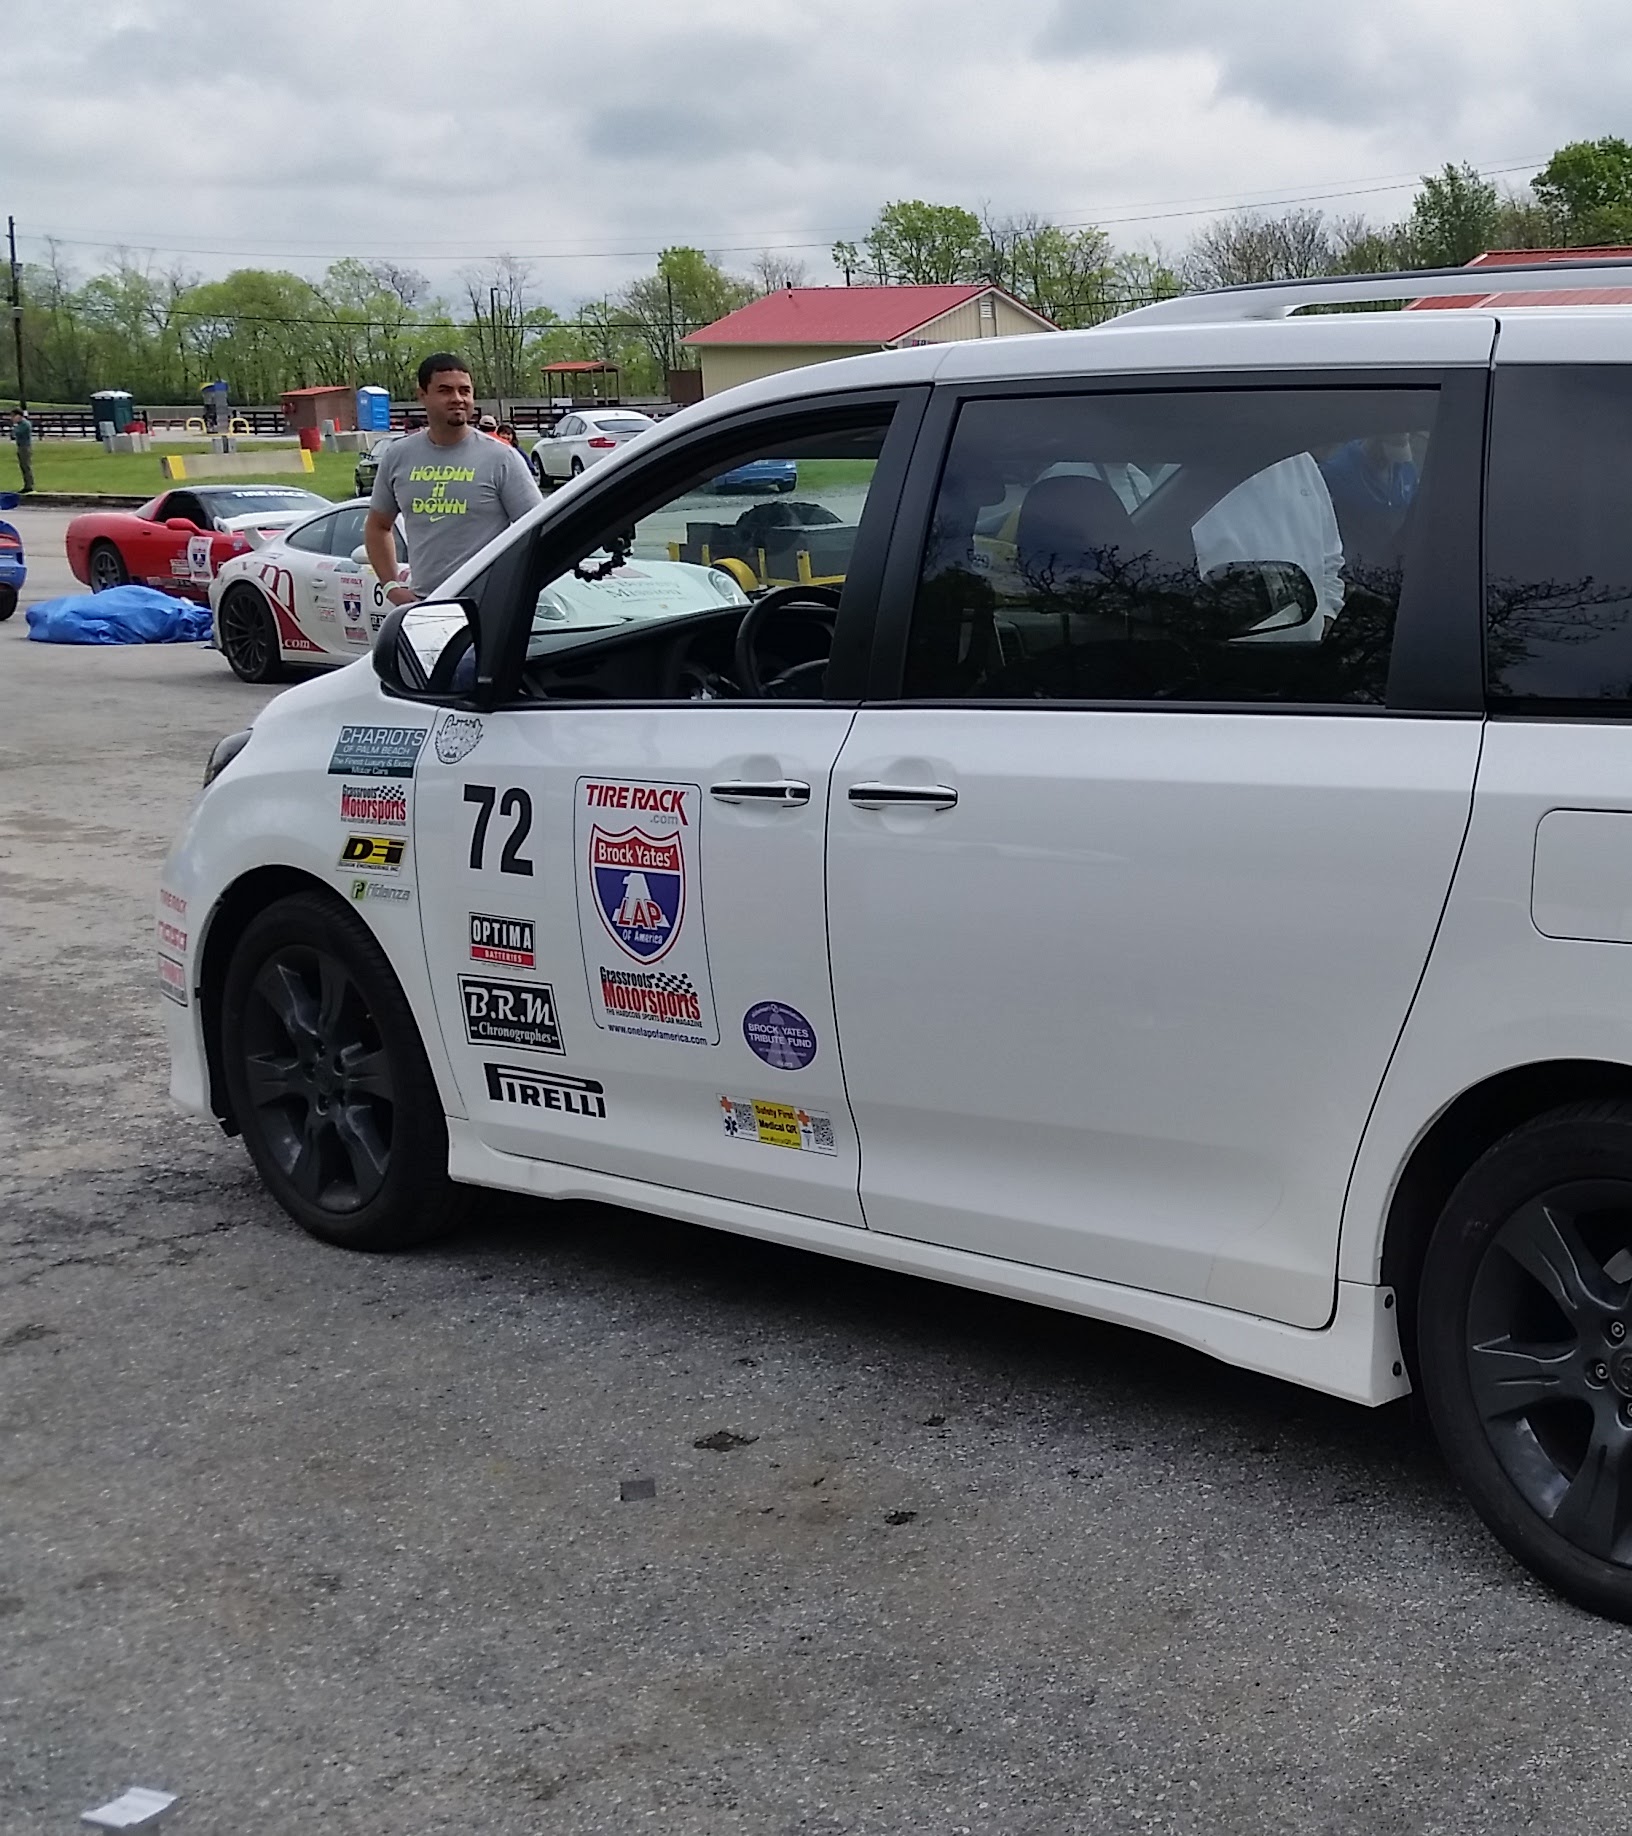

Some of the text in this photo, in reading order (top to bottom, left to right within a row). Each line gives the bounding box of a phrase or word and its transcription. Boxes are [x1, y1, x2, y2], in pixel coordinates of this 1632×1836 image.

[409, 465, 475, 482] HOLDIN
[432, 481, 449, 497] IT
[412, 497, 467, 514] DOWN
[283, 639, 310, 649] .com
[340, 727, 425, 746] CHARIOTS
[343, 745, 410, 755] OF PALM BEACH
[342, 784, 377, 798] Grassroots
[341, 795, 406, 824] Motorsports
[586, 784, 689, 826] TIRE RACK
[650, 814, 679, 825] .com
[463, 783, 534, 877] 72
[598, 841, 674, 867] Brock Yates'
[617, 899, 664, 930] LAP
[472, 918, 533, 950] OPTIMA
[633, 930, 664, 945] America
[484, 949, 523, 964] BATTERIES
[599, 965, 654, 989] Grassroots
[601, 980, 701, 1023] Motorsports
[641, 1012, 661, 1022] SPORTS
[664, 1016, 675, 1024] CAR
[675, 1017, 703, 1028] MAGAZINE
[607, 1024, 708, 1046] www.onelapofamerica.com
[747, 1023, 809, 1038] BROCK YATES
[748, 1032, 812, 1048] TRIBUTE FUND
[482, 1062, 606, 1119] PIRELLI
[755, 1104, 795, 1120] Safety First
[758, 1118, 798, 1135] Medical QR
